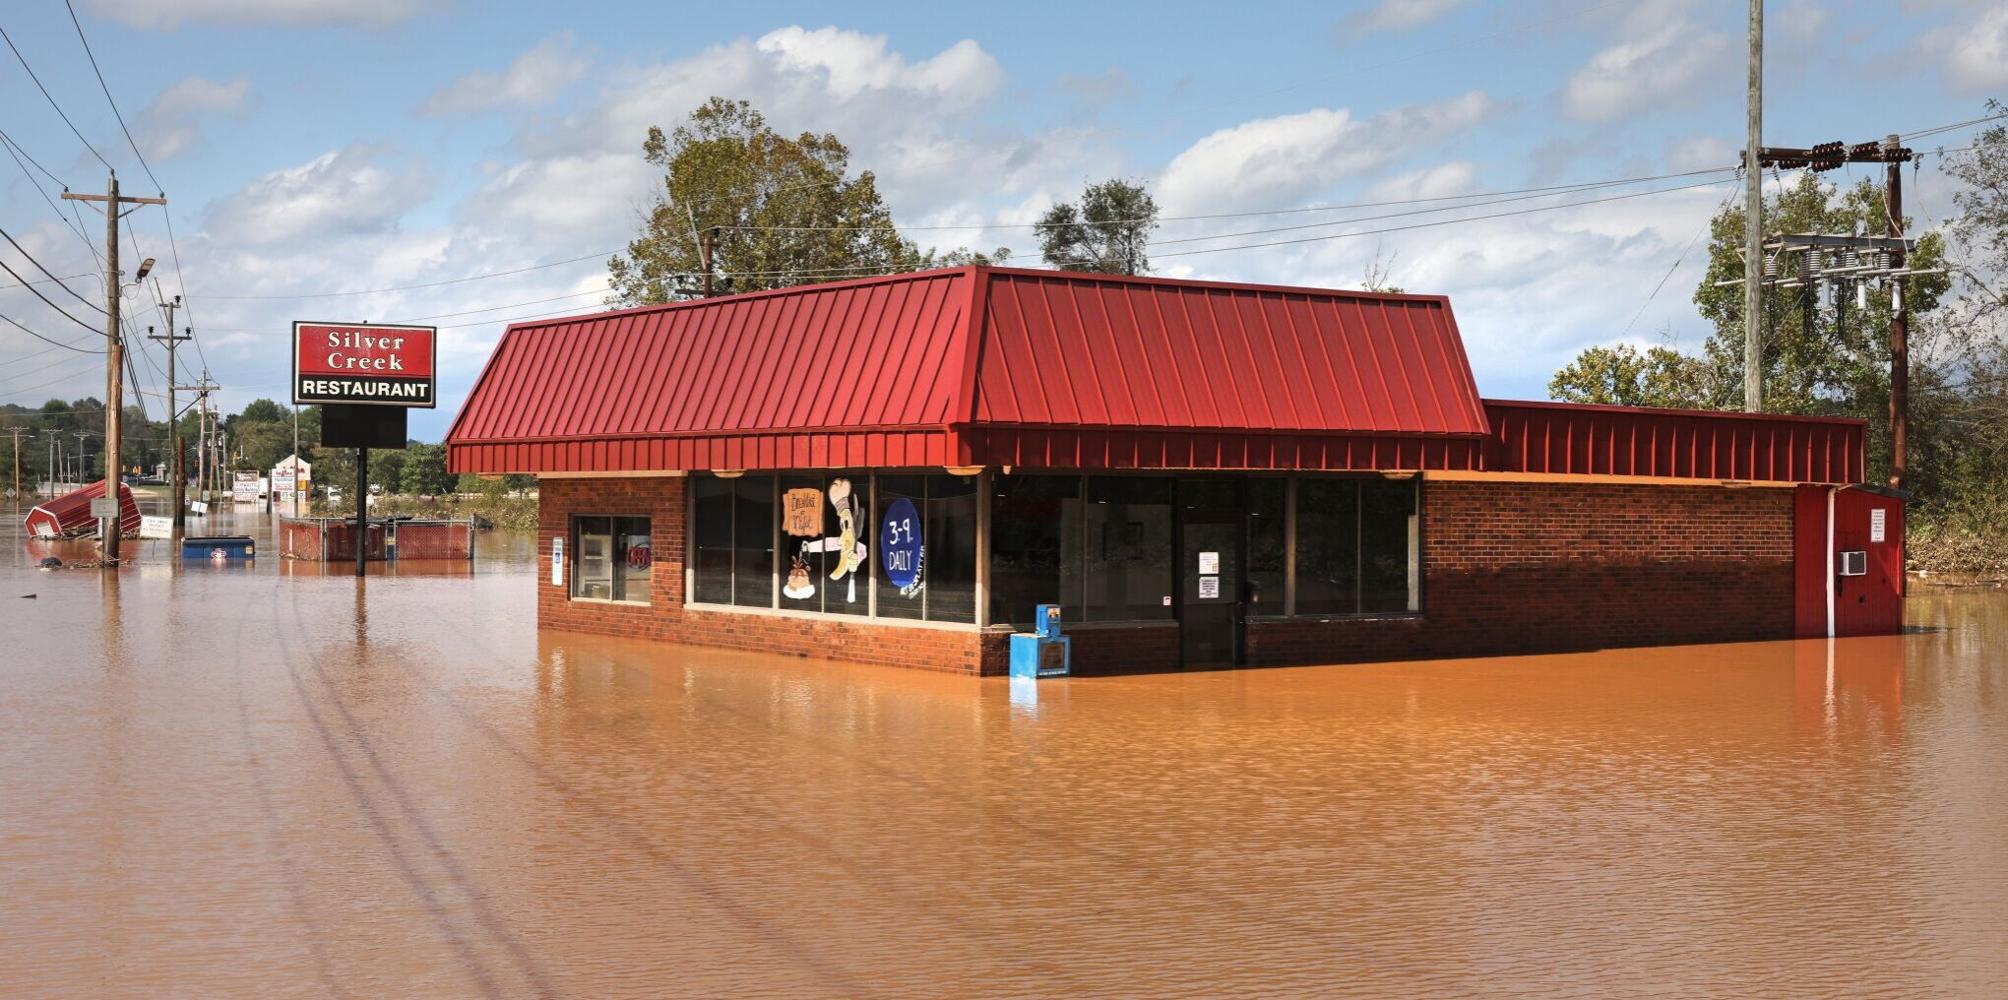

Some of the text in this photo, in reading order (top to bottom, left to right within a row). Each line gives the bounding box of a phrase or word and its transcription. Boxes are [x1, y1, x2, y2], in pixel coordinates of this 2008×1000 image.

[328, 331, 404, 350] Silver
[327, 352, 403, 370] Creek
[302, 380, 428, 397] RESTAURANT
[888, 550, 913, 571] DAILY
